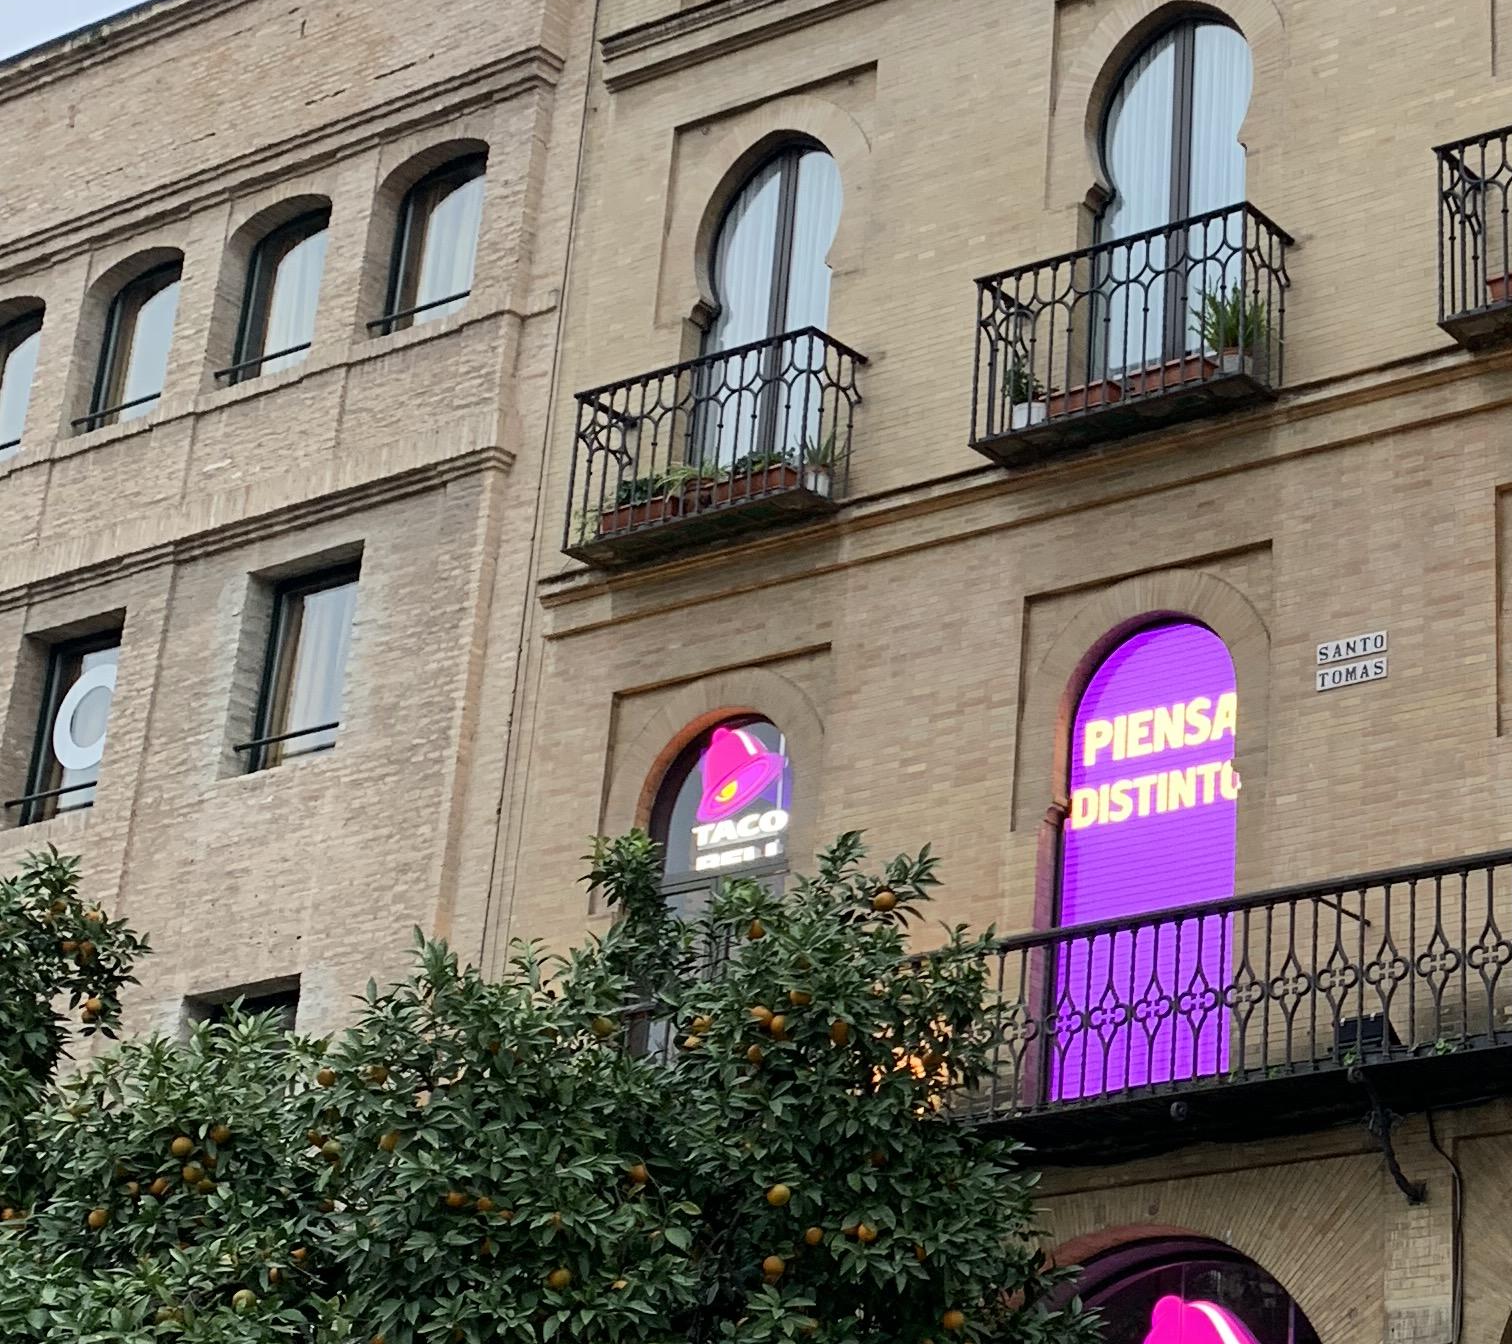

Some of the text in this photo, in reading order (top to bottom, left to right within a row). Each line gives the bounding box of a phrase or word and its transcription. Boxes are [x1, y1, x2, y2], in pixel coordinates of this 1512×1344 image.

[1318, 634, 1384, 662] SANTO
[1318, 661, 1384, 688] TOMAS
[1083, 692, 1238, 767] PIENSA
[691, 810, 789, 848] TACO
